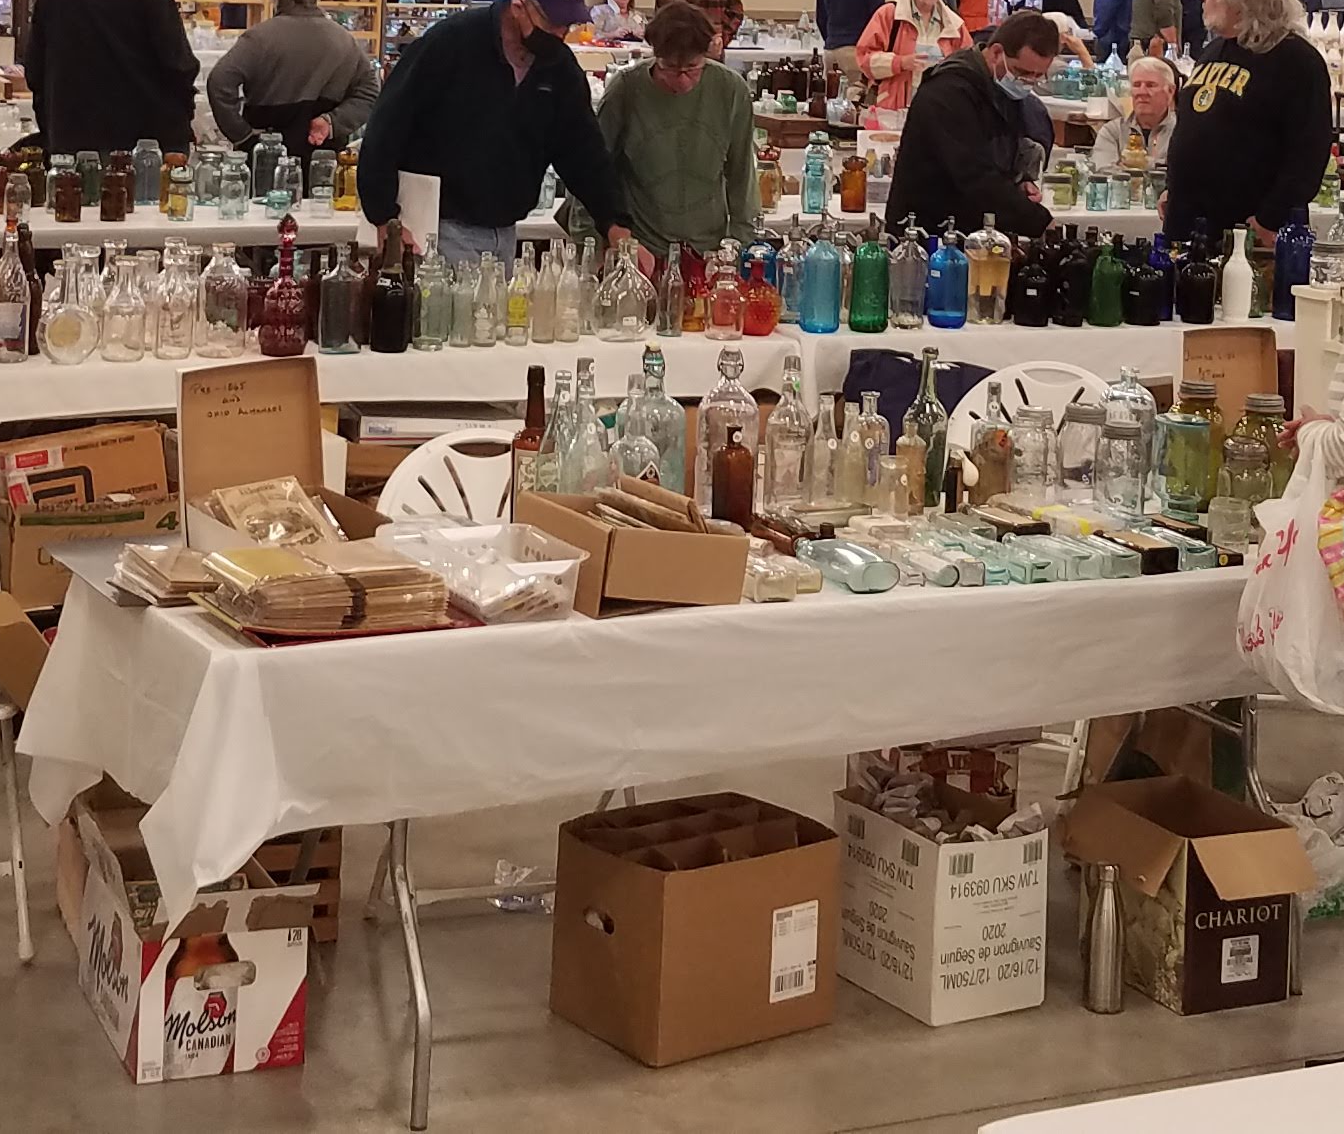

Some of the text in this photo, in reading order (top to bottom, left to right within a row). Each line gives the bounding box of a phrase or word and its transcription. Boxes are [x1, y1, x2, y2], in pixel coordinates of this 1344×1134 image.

[156, 511, 179, 531] 4
[950, 869, 1039, 900] TJW SKU 093914
[1195, 903, 1283, 930] CHARIOT
[982, 922, 1007, 941] 2020
[940, 935, 1042, 966] Sauvignon de Seguin
[940, 958, 1041, 990] 12/16/20 12/750ML
[164, 1008, 236, 1049] Molson
[185, 1033, 232, 1052] CANADIAN
